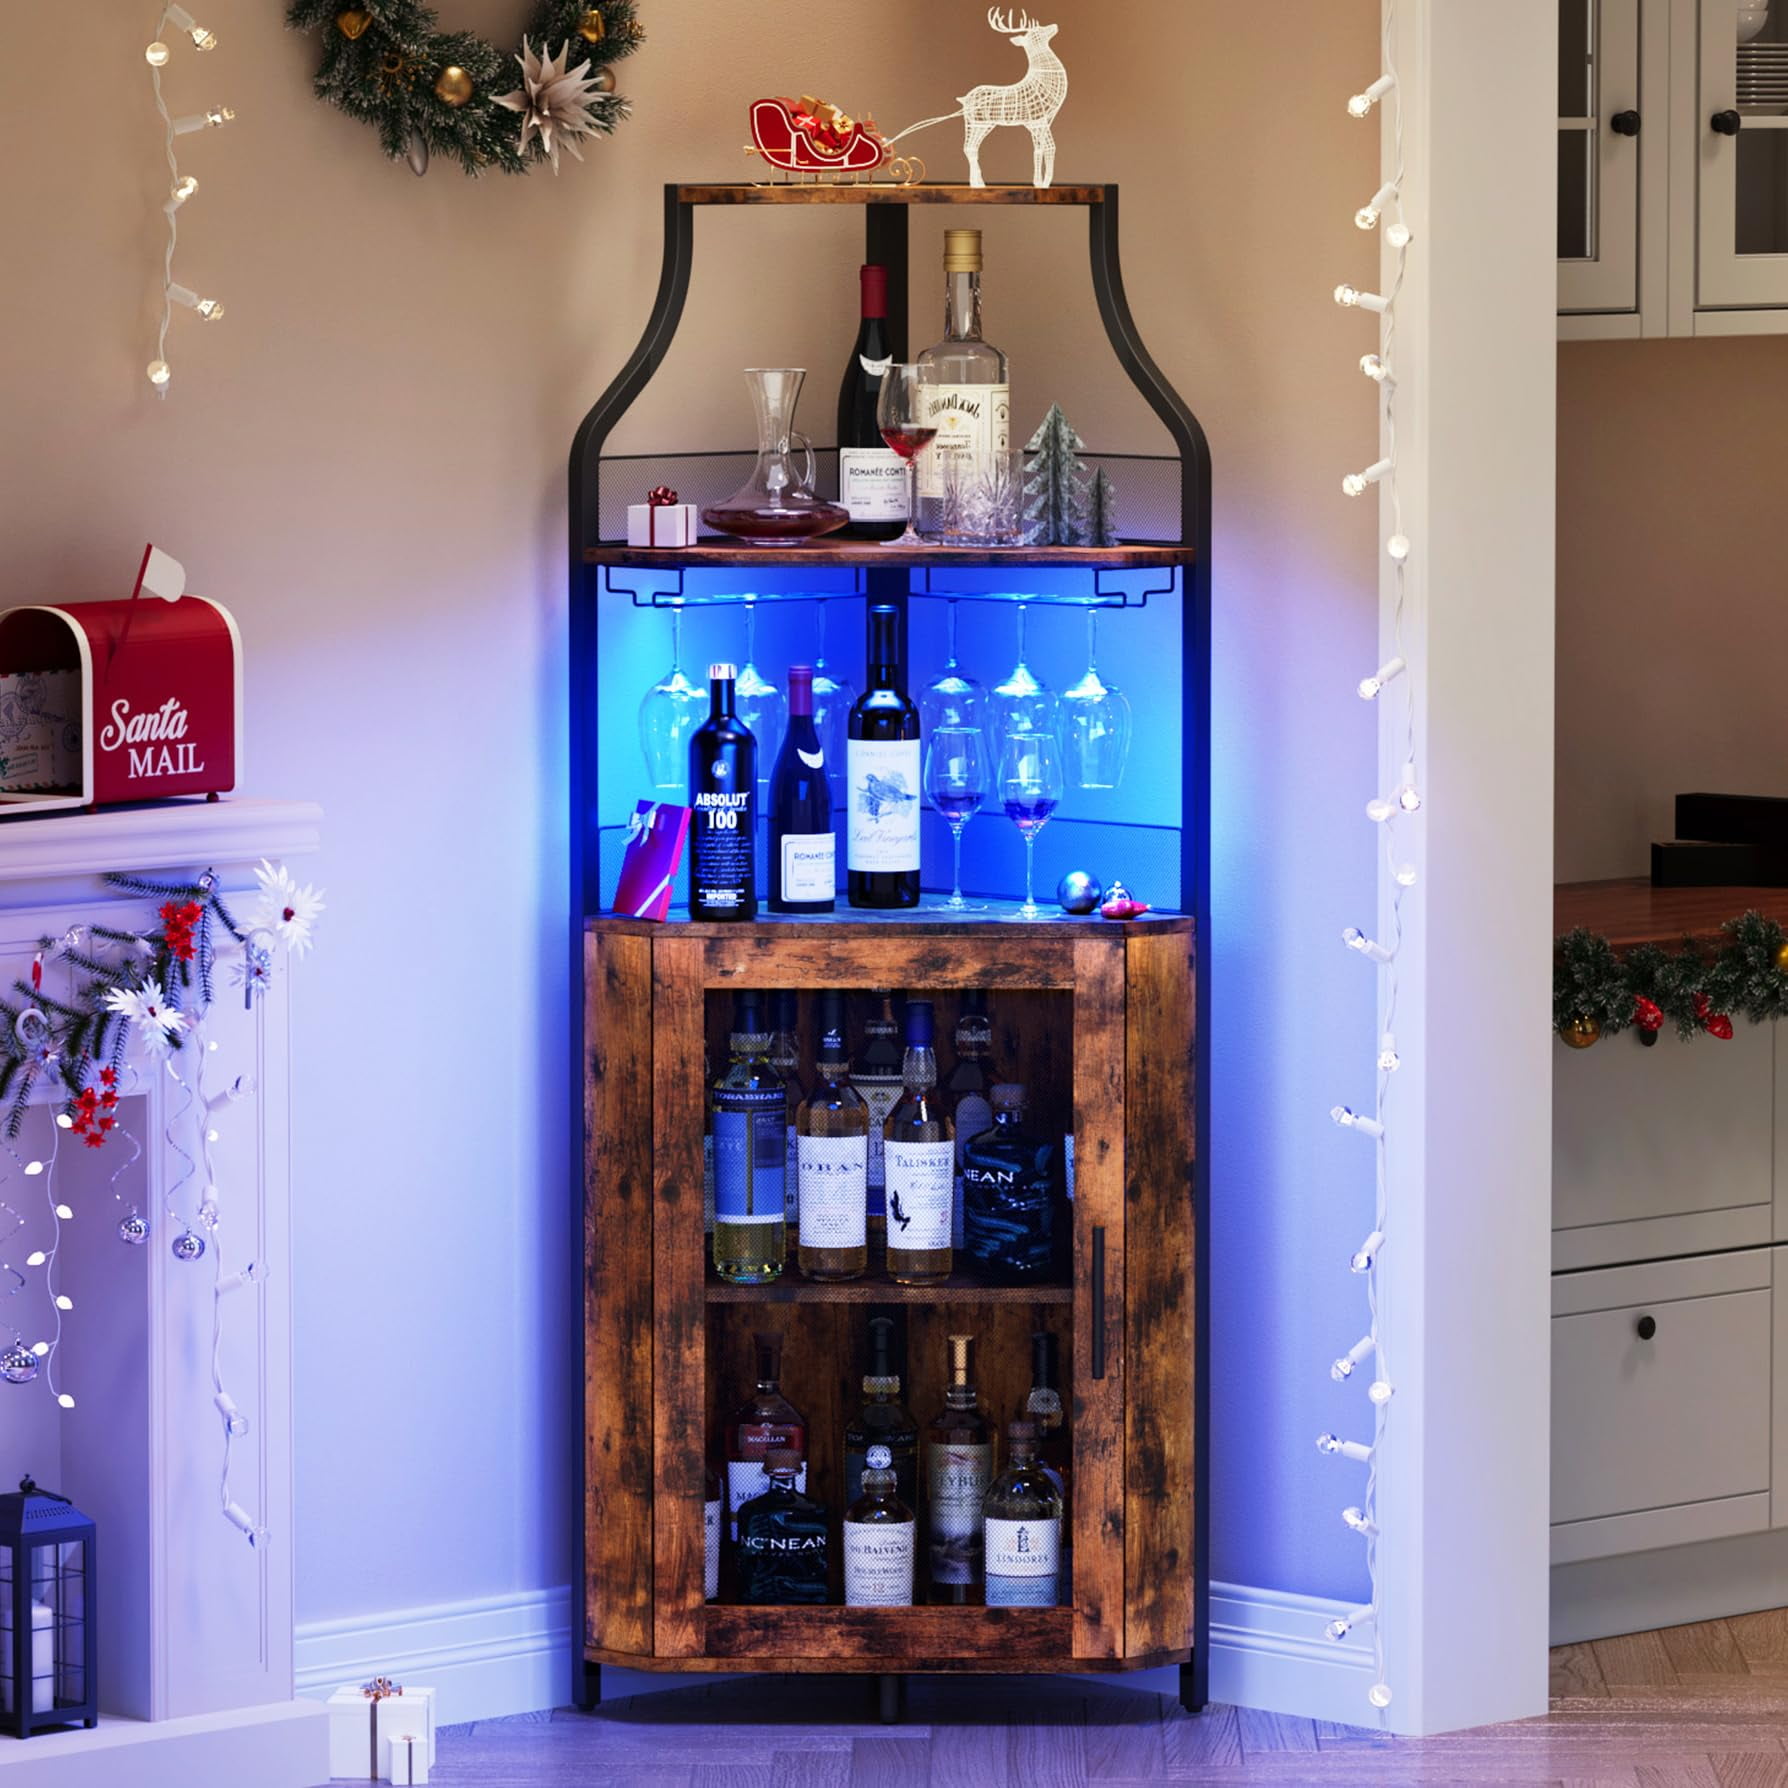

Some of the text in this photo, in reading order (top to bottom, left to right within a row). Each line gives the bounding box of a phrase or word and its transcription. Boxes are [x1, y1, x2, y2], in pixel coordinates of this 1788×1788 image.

[849, 466, 883, 477] ROMANÉE
[100, 697, 188, 751] Santa
[128, 743, 205, 779] MAIL
[695, 792, 748, 806] ABSOLUT
[707, 811, 738, 829] 100
